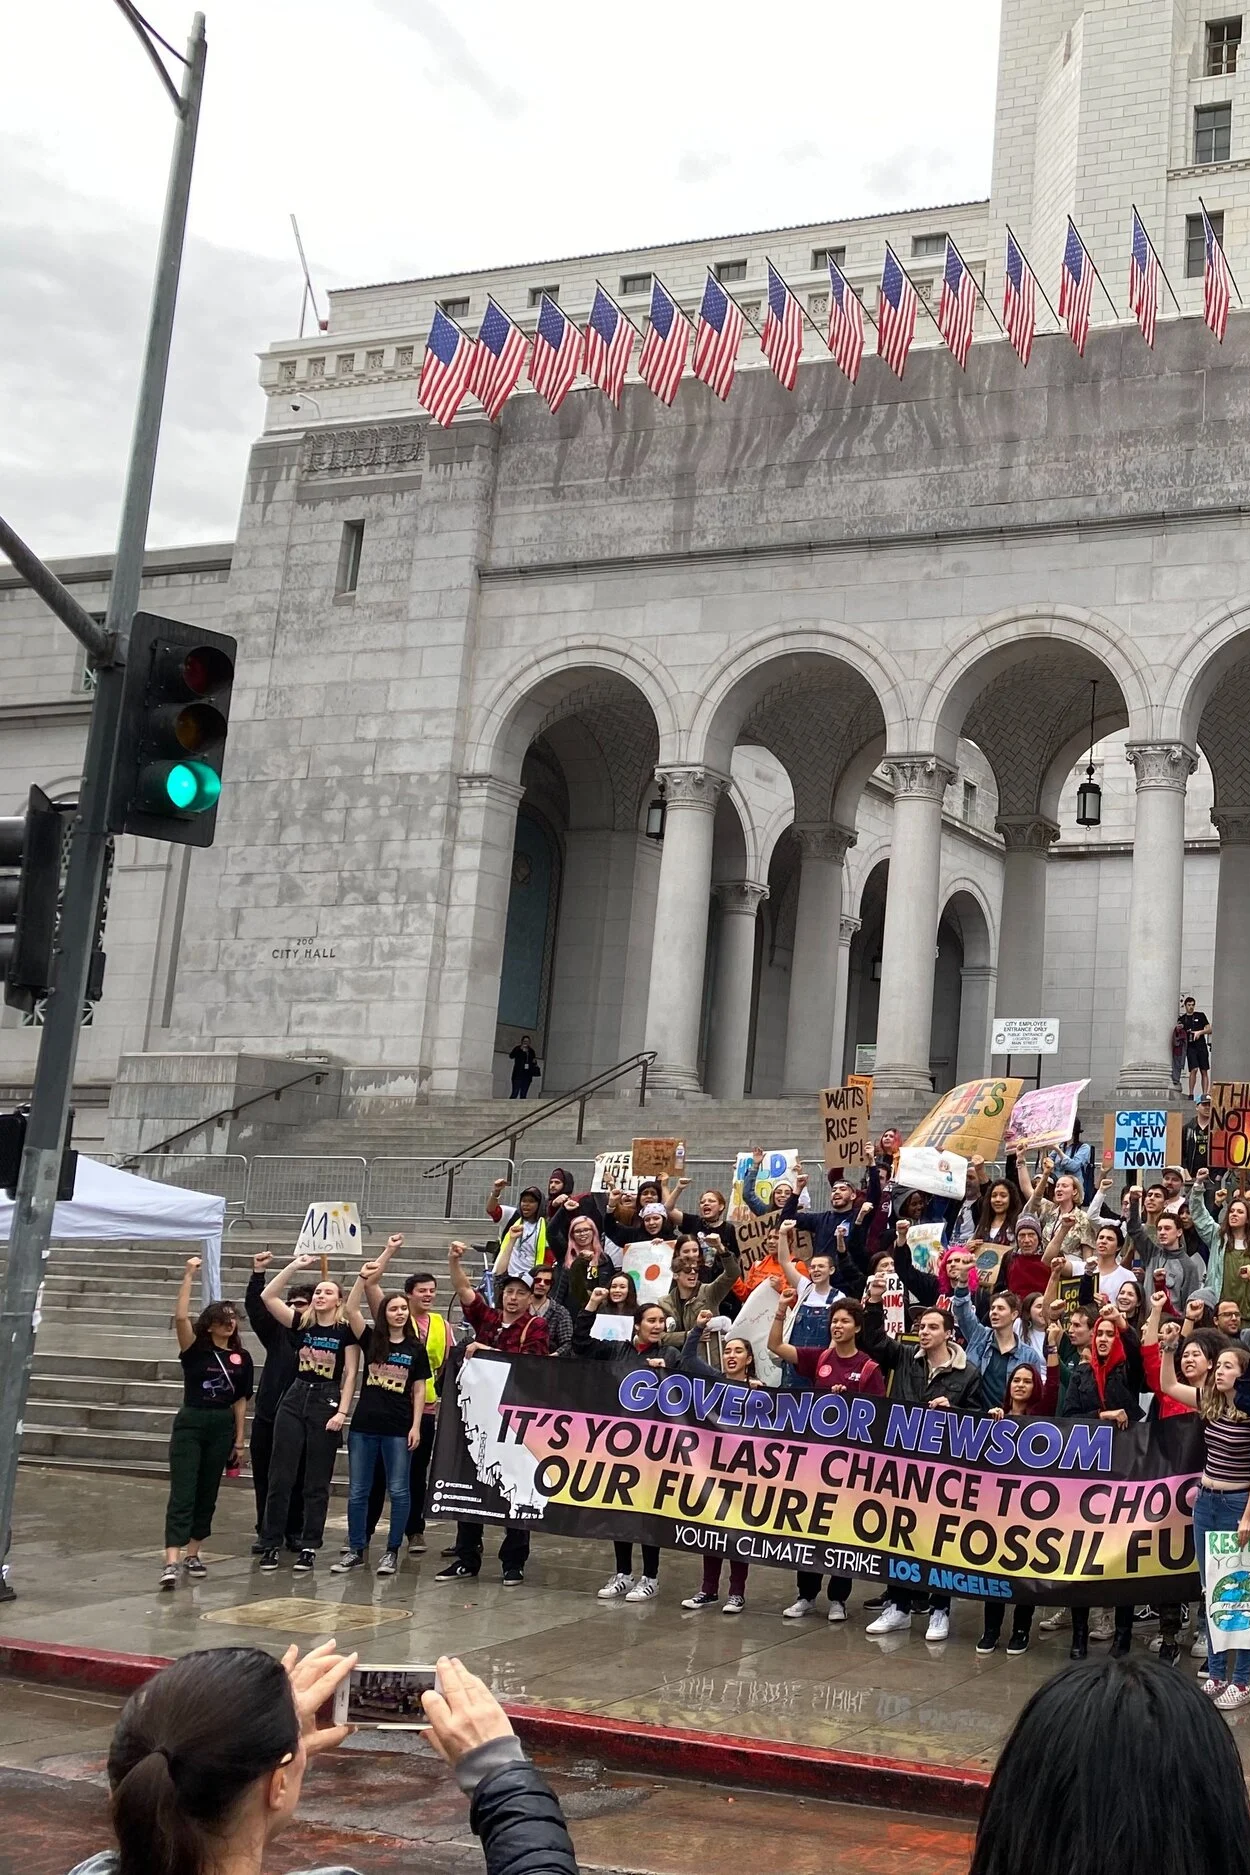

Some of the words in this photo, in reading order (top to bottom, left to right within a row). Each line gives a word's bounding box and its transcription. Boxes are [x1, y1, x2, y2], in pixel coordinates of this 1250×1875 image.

[272, 949, 299, 959] CITY
[304, 948, 336, 958] HALL
[296, 938, 314, 946] 200
[824, 1087, 864, 1110] WATTS
[825, 1116, 858, 1142] RISE
[1116, 1112, 1168, 1126] GREEN
[1132, 1126, 1166, 1138] NEW
[839, 1138, 865, 1164] UP!
[1116, 1138, 1160, 1152] DEAL
[1124, 1152, 1164, 1168] NOW!
[618, 1369, 876, 1444] GOVERNOR
[883, 1402, 1114, 1472] NEWSOM
[584, 1417, 700, 1467] YOUR
[708, 1435, 808, 1482] LAST
[820, 1450, 982, 1513] CHANCE
[996, 1478, 1060, 1521] TO
[534, 1455, 640, 1506] OUR
[653, 1469, 838, 1535] FUTURE
[852, 1498, 918, 1550] OR
[931, 1514, 1105, 1576] FOSSIL
[674, 1524, 727, 1552] YOUTH
[736, 1536, 816, 1566] CLIMATE
[824, 1548, 882, 1576] STRIKE
[888, 1558, 922, 1583] LOS
[928, 1572, 1013, 1598] ANGELES
